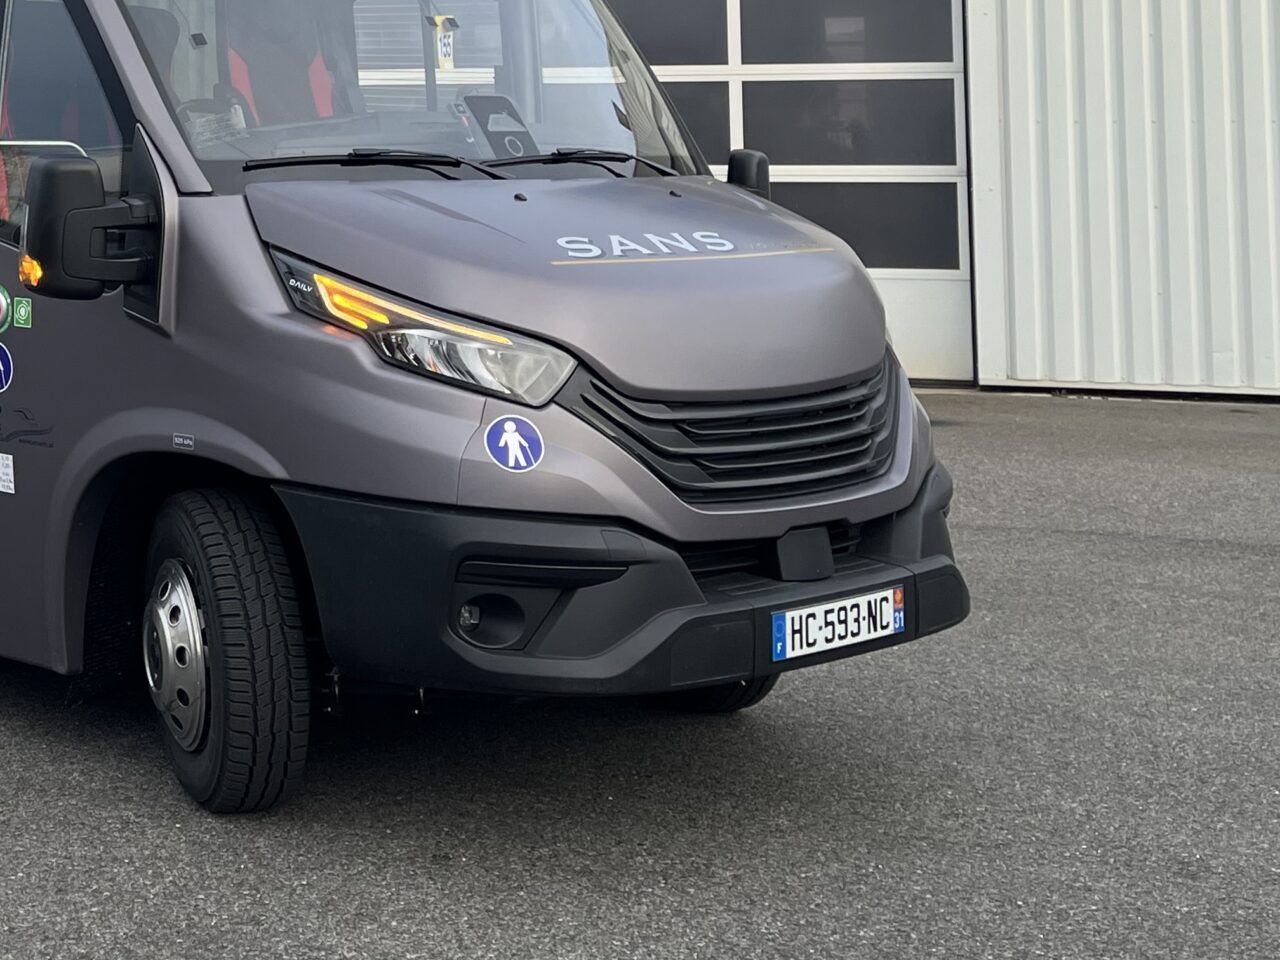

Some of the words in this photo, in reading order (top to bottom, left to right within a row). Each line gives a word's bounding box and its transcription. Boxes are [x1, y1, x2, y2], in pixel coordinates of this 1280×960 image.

[556, 231, 736, 258] SANS
[288, 278, 313, 293] DAILY
[790, 596, 891, 652] HC-593-NC
[894, 611, 905, 630] 31
[776, 642, 783, 654] F
